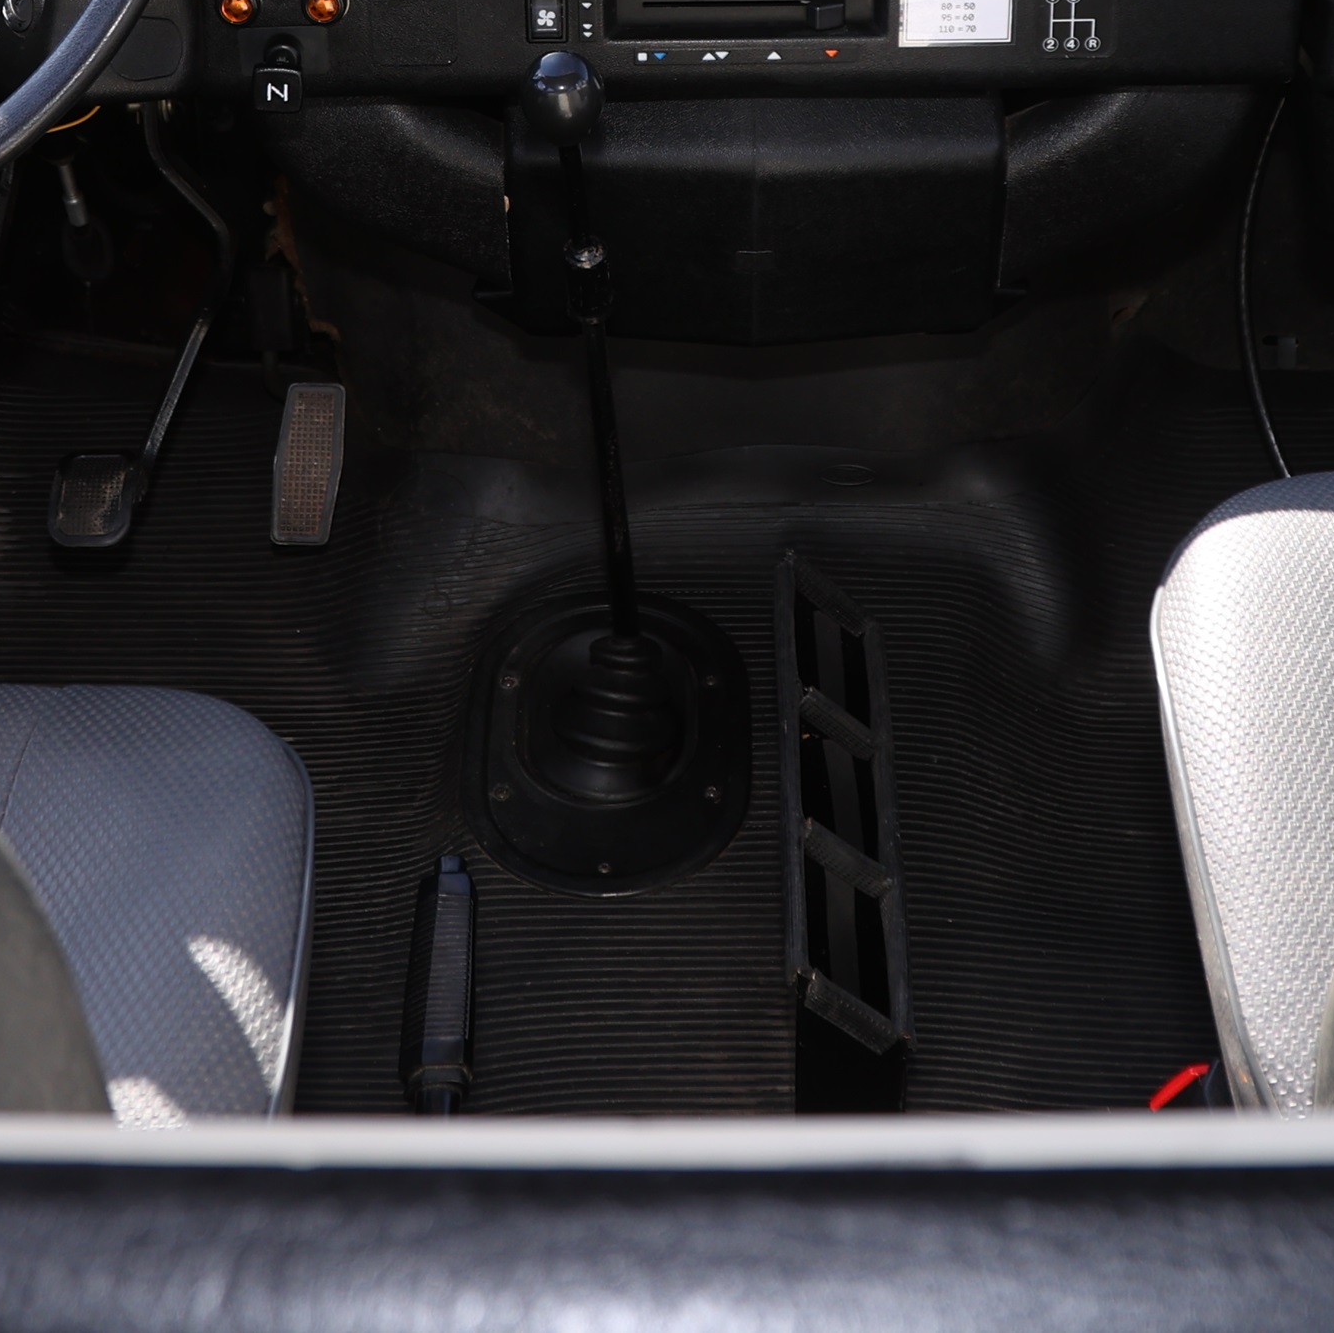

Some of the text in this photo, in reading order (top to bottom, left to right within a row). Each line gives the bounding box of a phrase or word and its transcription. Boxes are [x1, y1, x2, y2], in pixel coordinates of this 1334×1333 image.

[966, 25, 977, 33] 70
[1047, 39, 1097, 49] 2 4 R
[267, 83, 289, 102] N
